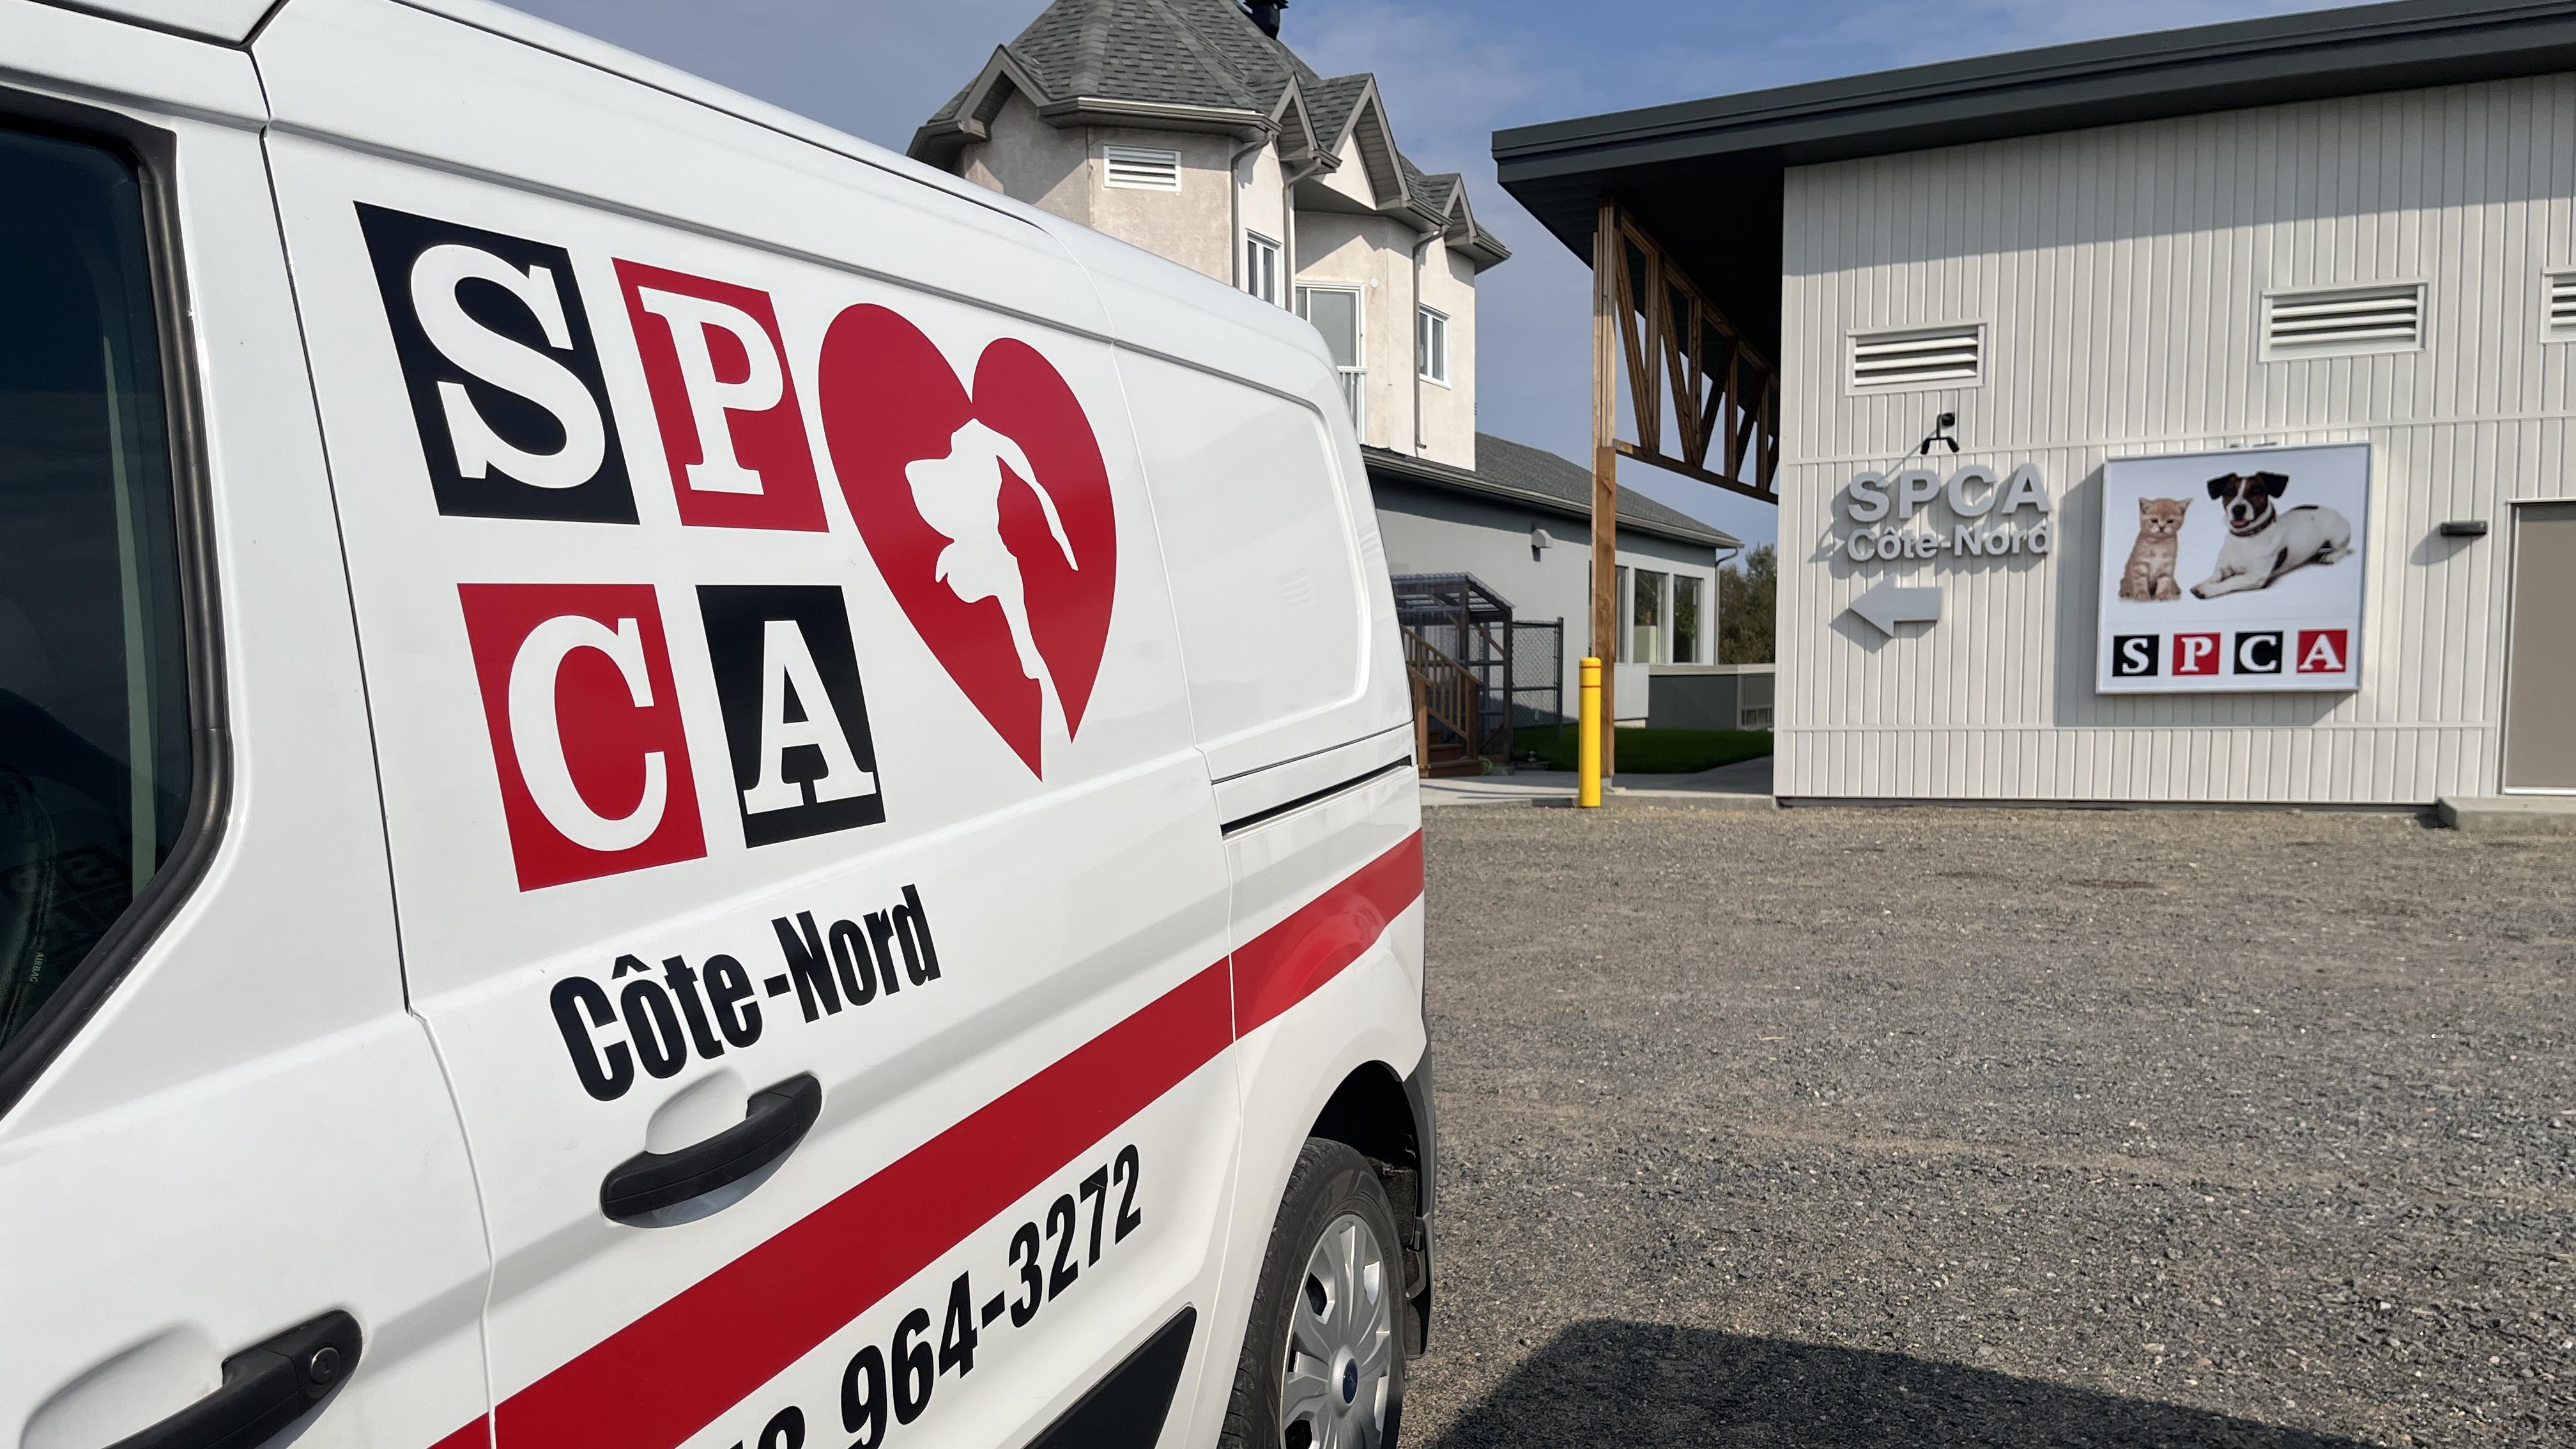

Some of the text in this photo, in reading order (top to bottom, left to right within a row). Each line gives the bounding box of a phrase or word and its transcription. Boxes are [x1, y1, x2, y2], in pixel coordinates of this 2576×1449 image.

[1848, 463, 2051, 522] SPCA
[1848, 521, 2053, 562] Côte-Nord
[2122, 633, 2343, 674] SPCA
[550, 884, 941, 1101] Côte-Nord
[840, 1144, 1142, 1449] 964-3272
